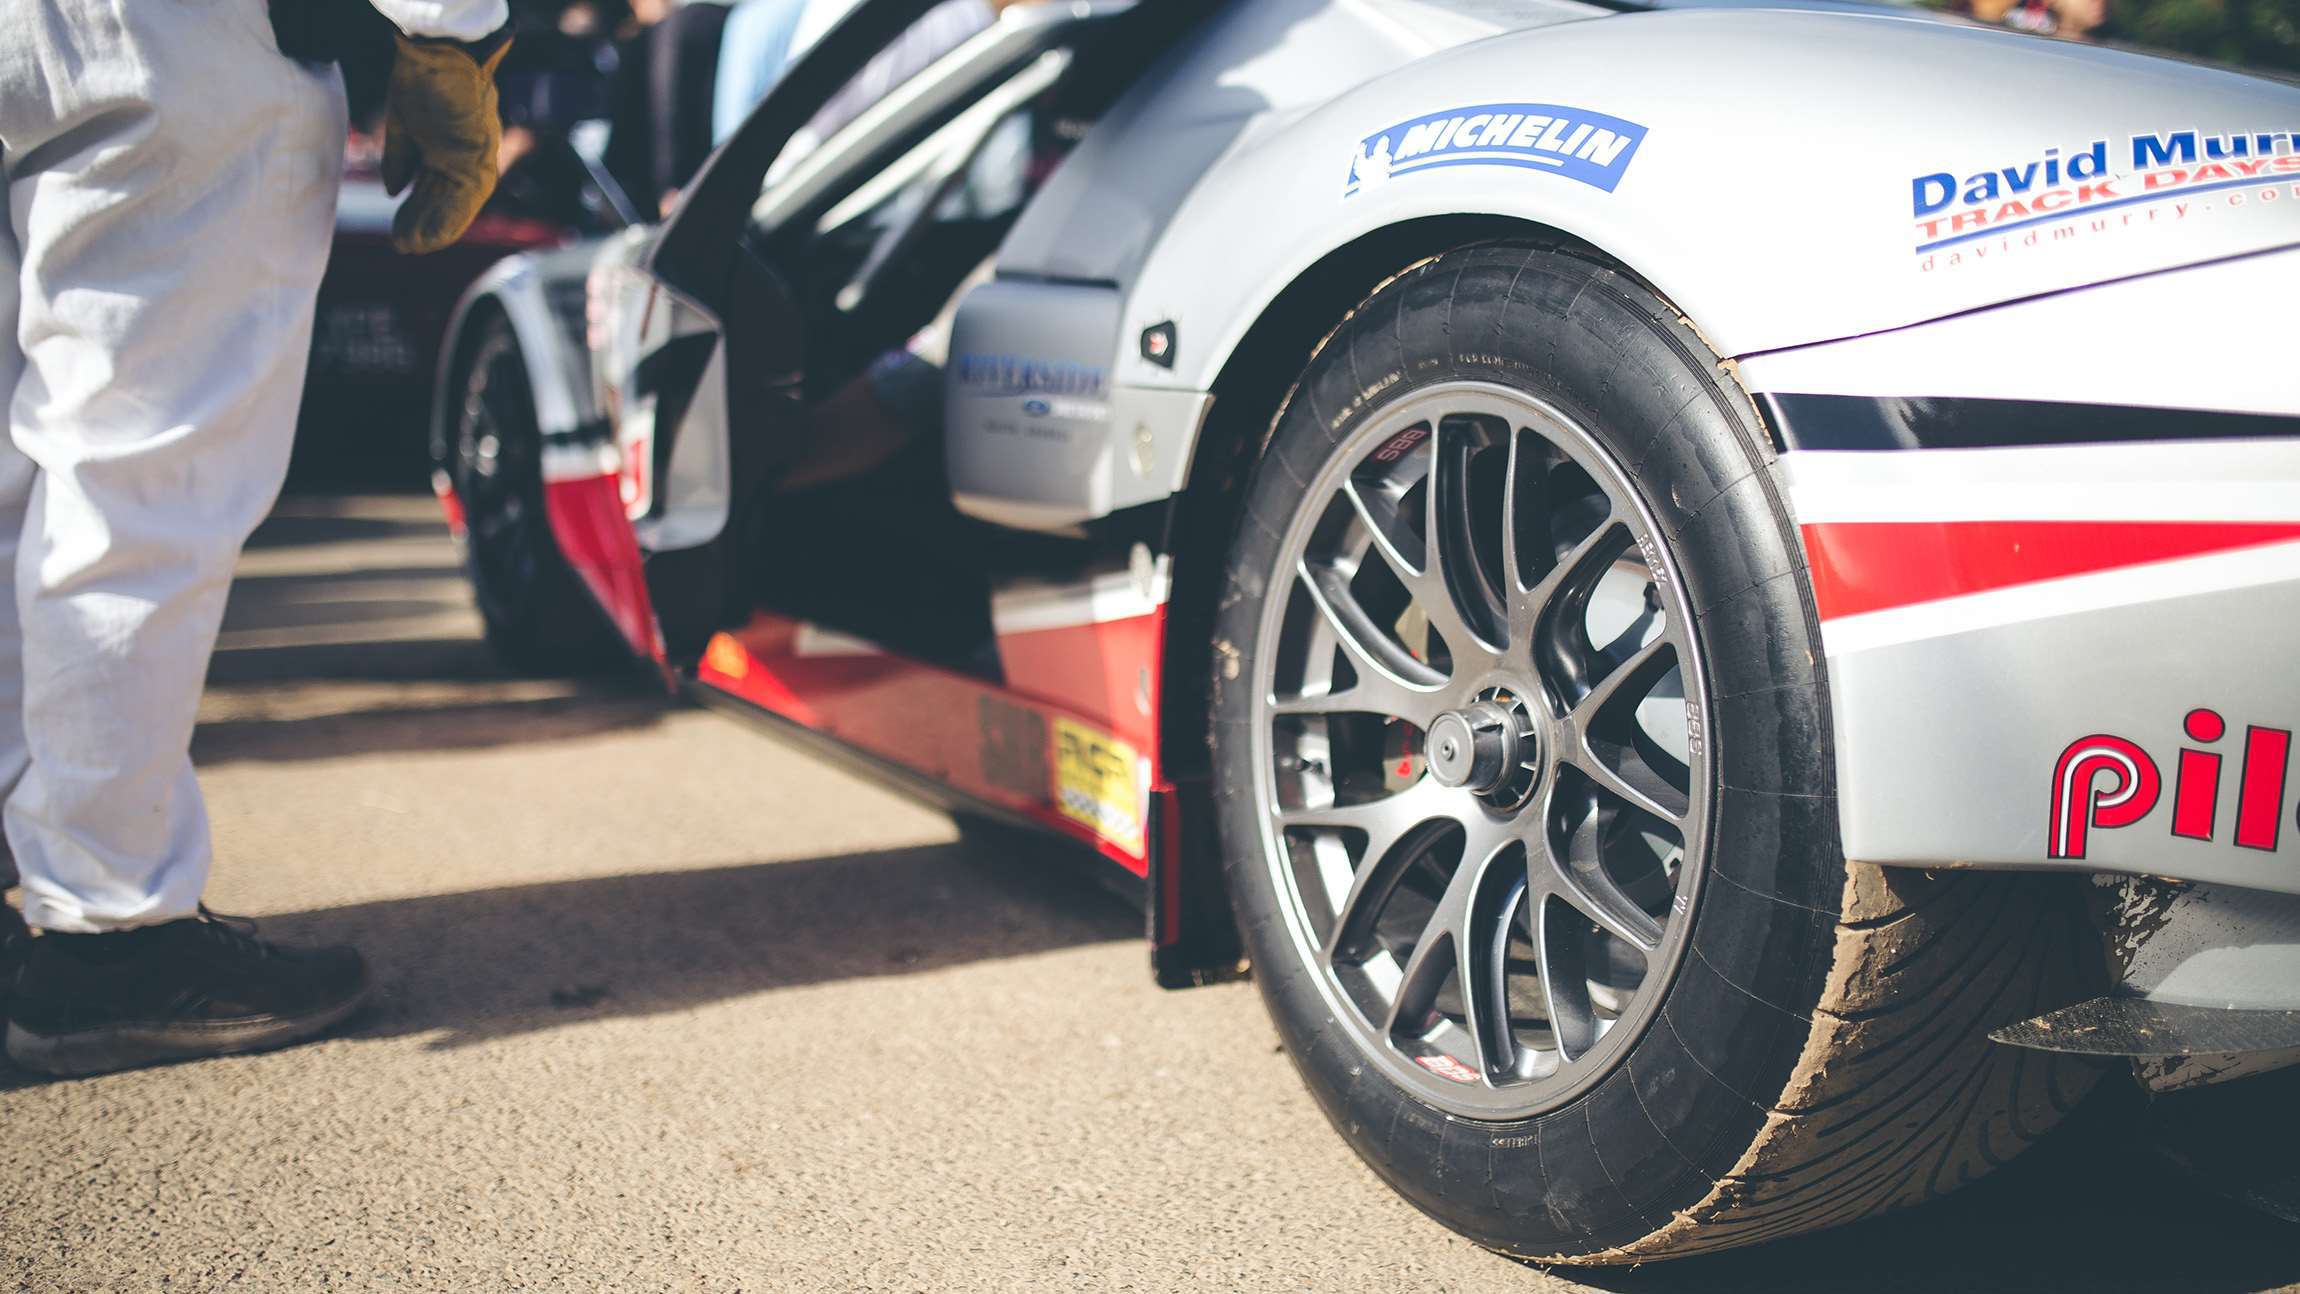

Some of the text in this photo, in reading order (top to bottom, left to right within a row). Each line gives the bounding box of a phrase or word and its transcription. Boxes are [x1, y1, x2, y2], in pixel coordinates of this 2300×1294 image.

[1394, 113, 1632, 167] MICHELIN
[1912, 140, 2107, 218] David
[1916, 180, 2120, 239] TRACK
[1922, 186, 2300, 272] davidmurry.co
[1375, 430, 1425, 462] BBS
[2047, 708, 2300, 860] pil
